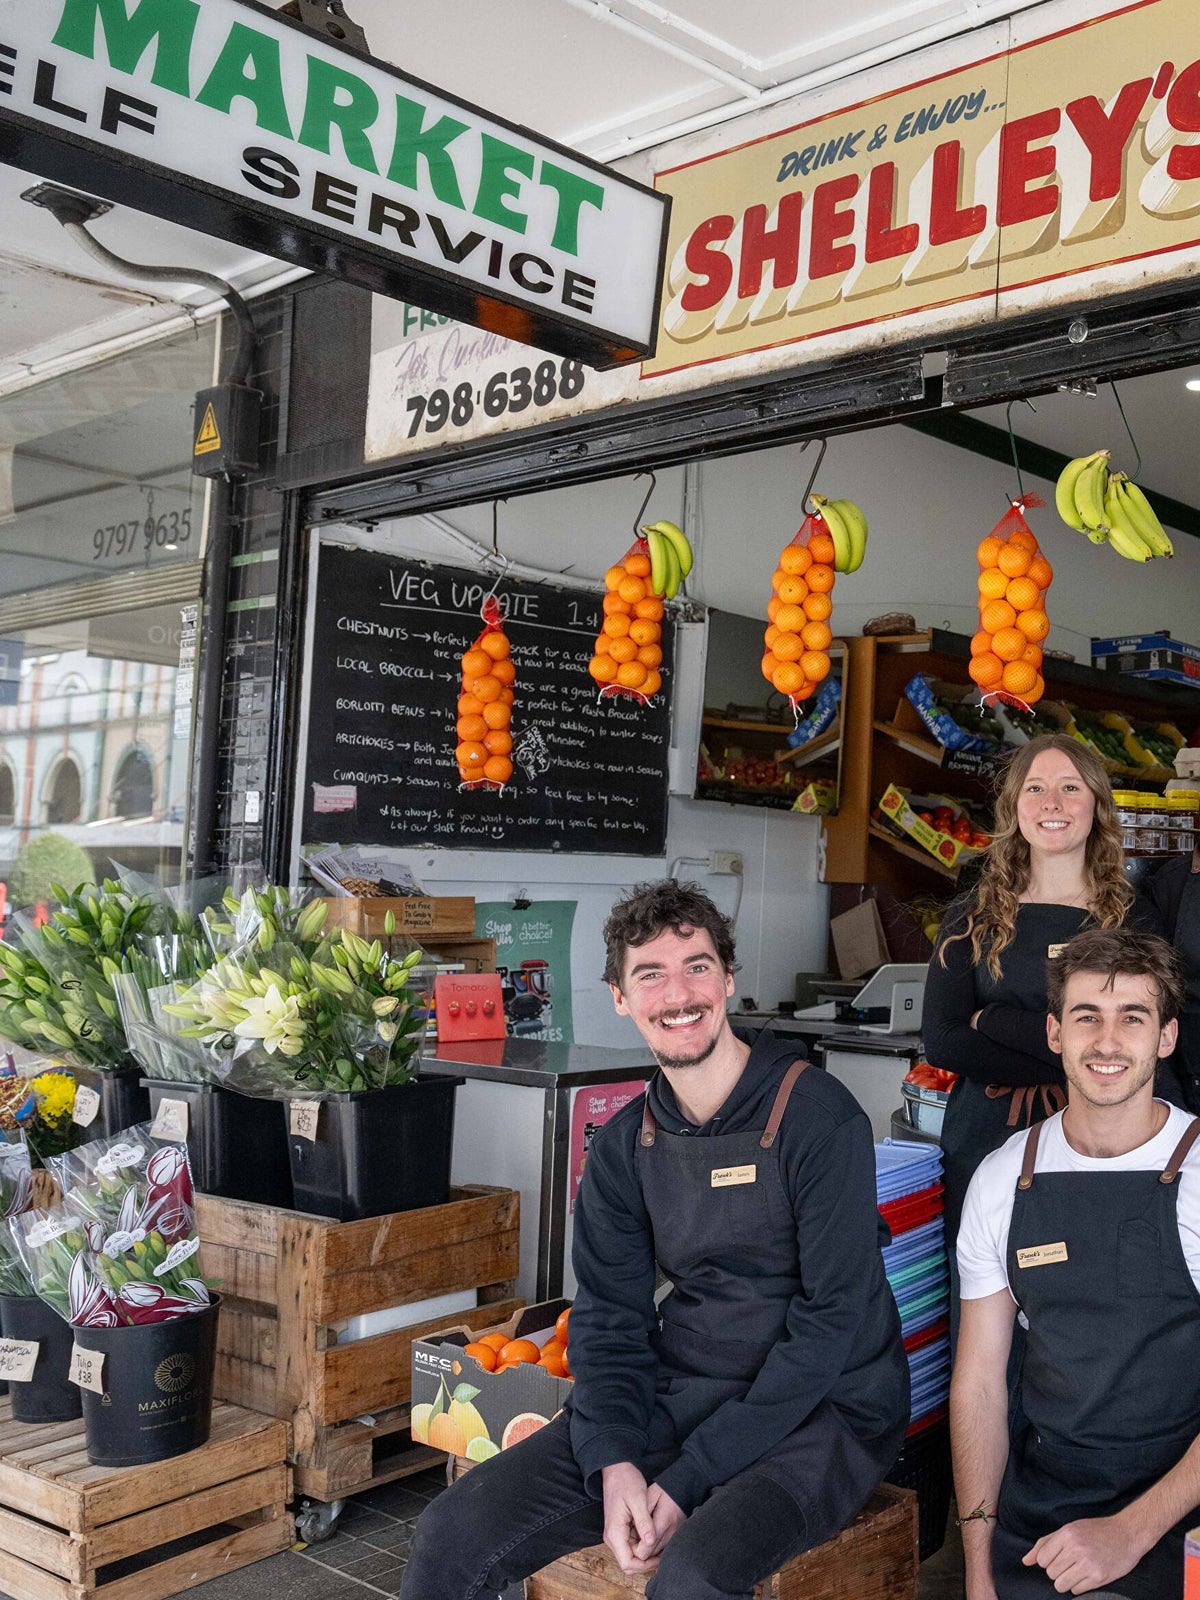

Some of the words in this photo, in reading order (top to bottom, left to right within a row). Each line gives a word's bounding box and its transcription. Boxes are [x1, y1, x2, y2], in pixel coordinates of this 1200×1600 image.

[52, 0, 604, 256] MARKET
[777, 133, 861, 183] DRINK
[866, 124, 888, 152] &
[240, 146, 597, 314] SERVICE
[93, 517, 138, 560] 9797
[144, 507, 192, 550] 9635
[389, 569, 441, 606] VEG
[451, 582, 539, 618] UPDATE
[336, 616, 409, 640] CHESTNUTS
[433, 649, 450, 659] are
[336, 655, 374, 673] LOCAL
[379, 661, 434, 680] BROCCOLI
[527, 700, 559, 712] perfect
[335, 698, 385, 712] BORLOTTI
[391, 703, 426, 718] BEANS
[560, 720, 595, 737] addition
[335, 732, 395, 751] ARTICHOKES
[333, 768, 389, 784] CUMQUATS
[443, 777, 452, 790] is
[410, 822, 428, 831] our
[433, 821, 454, 833] staff
[460, 814, 476, 824] you
[517, 816, 541, 826] order
[544, 818, 565, 831] any
[485, 920, 512, 934] Shop
[451, 983, 489, 993] Tomato
[76, 1353, 93, 1369] Tulip
[415, 1350, 452, 1368] MFC
[78, 1371, 92, 1384] $38
